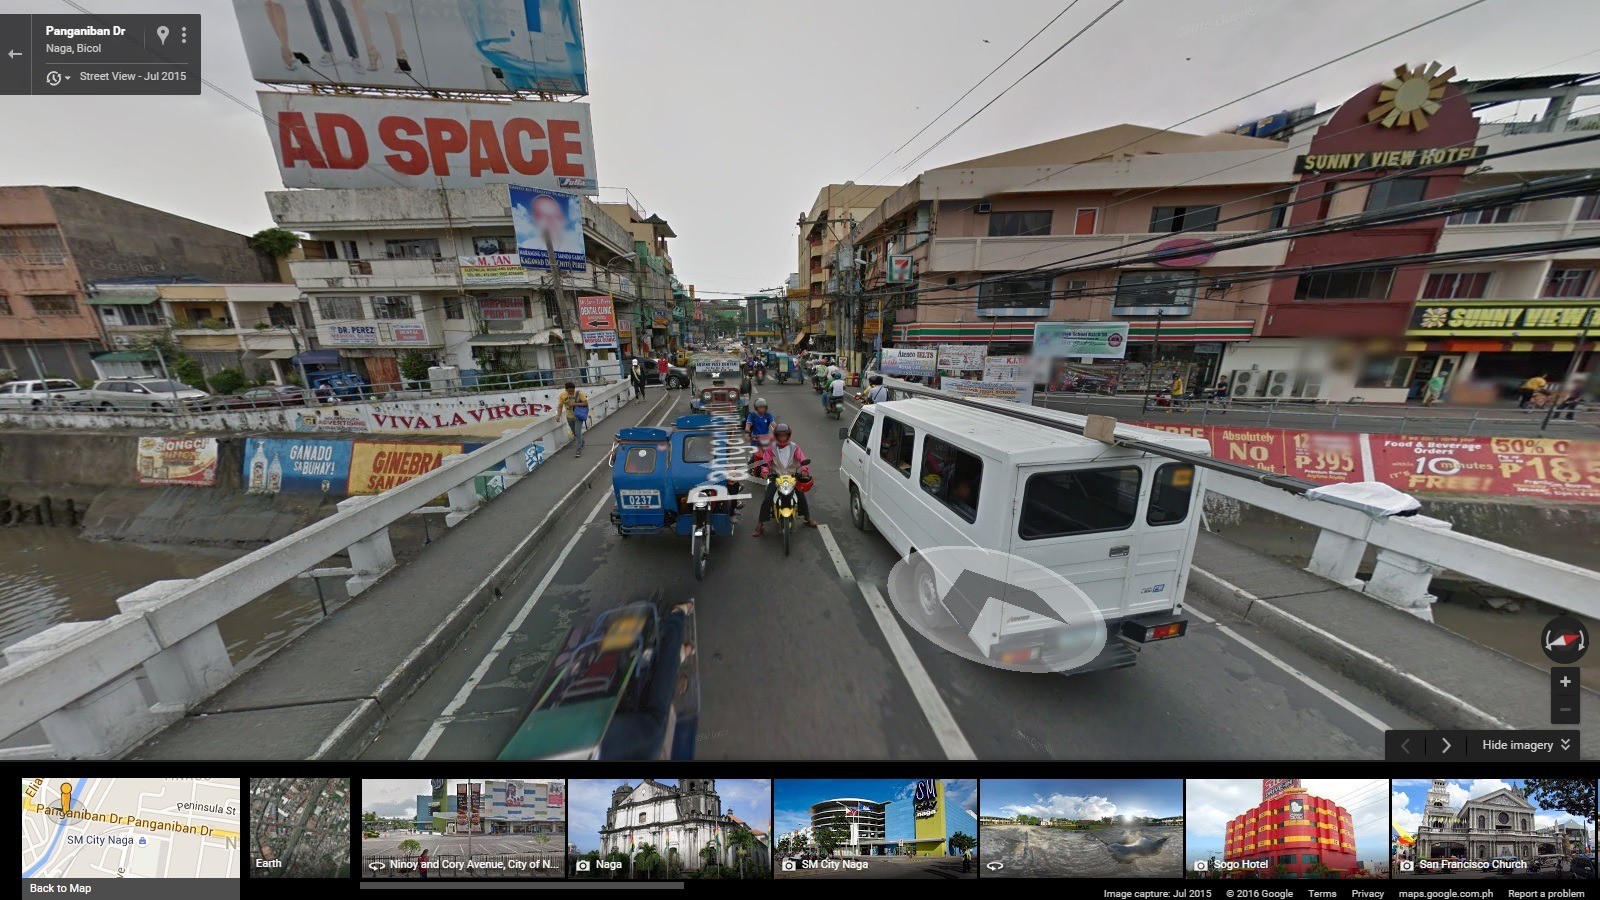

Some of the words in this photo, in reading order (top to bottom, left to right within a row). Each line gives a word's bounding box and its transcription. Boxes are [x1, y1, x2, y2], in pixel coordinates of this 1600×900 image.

[278, 111, 369, 170] AD
[378, 116, 585, 178] SPACE
[1304, 152, 1366, 171] SUNNY
[1369, 149, 1417, 168] VIEW
[1420, 146, 1478, 165] HOTEL
[477, 256, 490, 266] M.
[493, 255, 511, 265] TAN
[1448, 308, 1525, 328] SUNNY
[1522, 308, 1588, 327] VIEW
[338, 326, 350, 334] DR.
[352, 326, 375, 334] PEREZ
[372, 413, 431, 429] VIVA
[433, 413, 468, 428] LA
[1222, 430, 1275, 445] Absolutely
[1293, 433, 1309, 449] 12
[289, 445, 333, 461] GANADO
[1384, 440, 1413, 448] Food
[1427, 442, 1482, 452] Beverage
[1414, 447, 1454, 455] Orders
[1495, 438, 1545, 454] 50%
[294, 460, 303, 471] SA
[302, 461, 336, 476] BUHAY!
[372, 451, 443, 476] GINEBRA
[1416, 456, 1461, 475] 10
[367, 475, 395, 490] SAN
[1389, 470, 1411, 479] IT'S
[1408, 474, 1493, 491] FREE!
[629, 495, 652, 505] 0237
